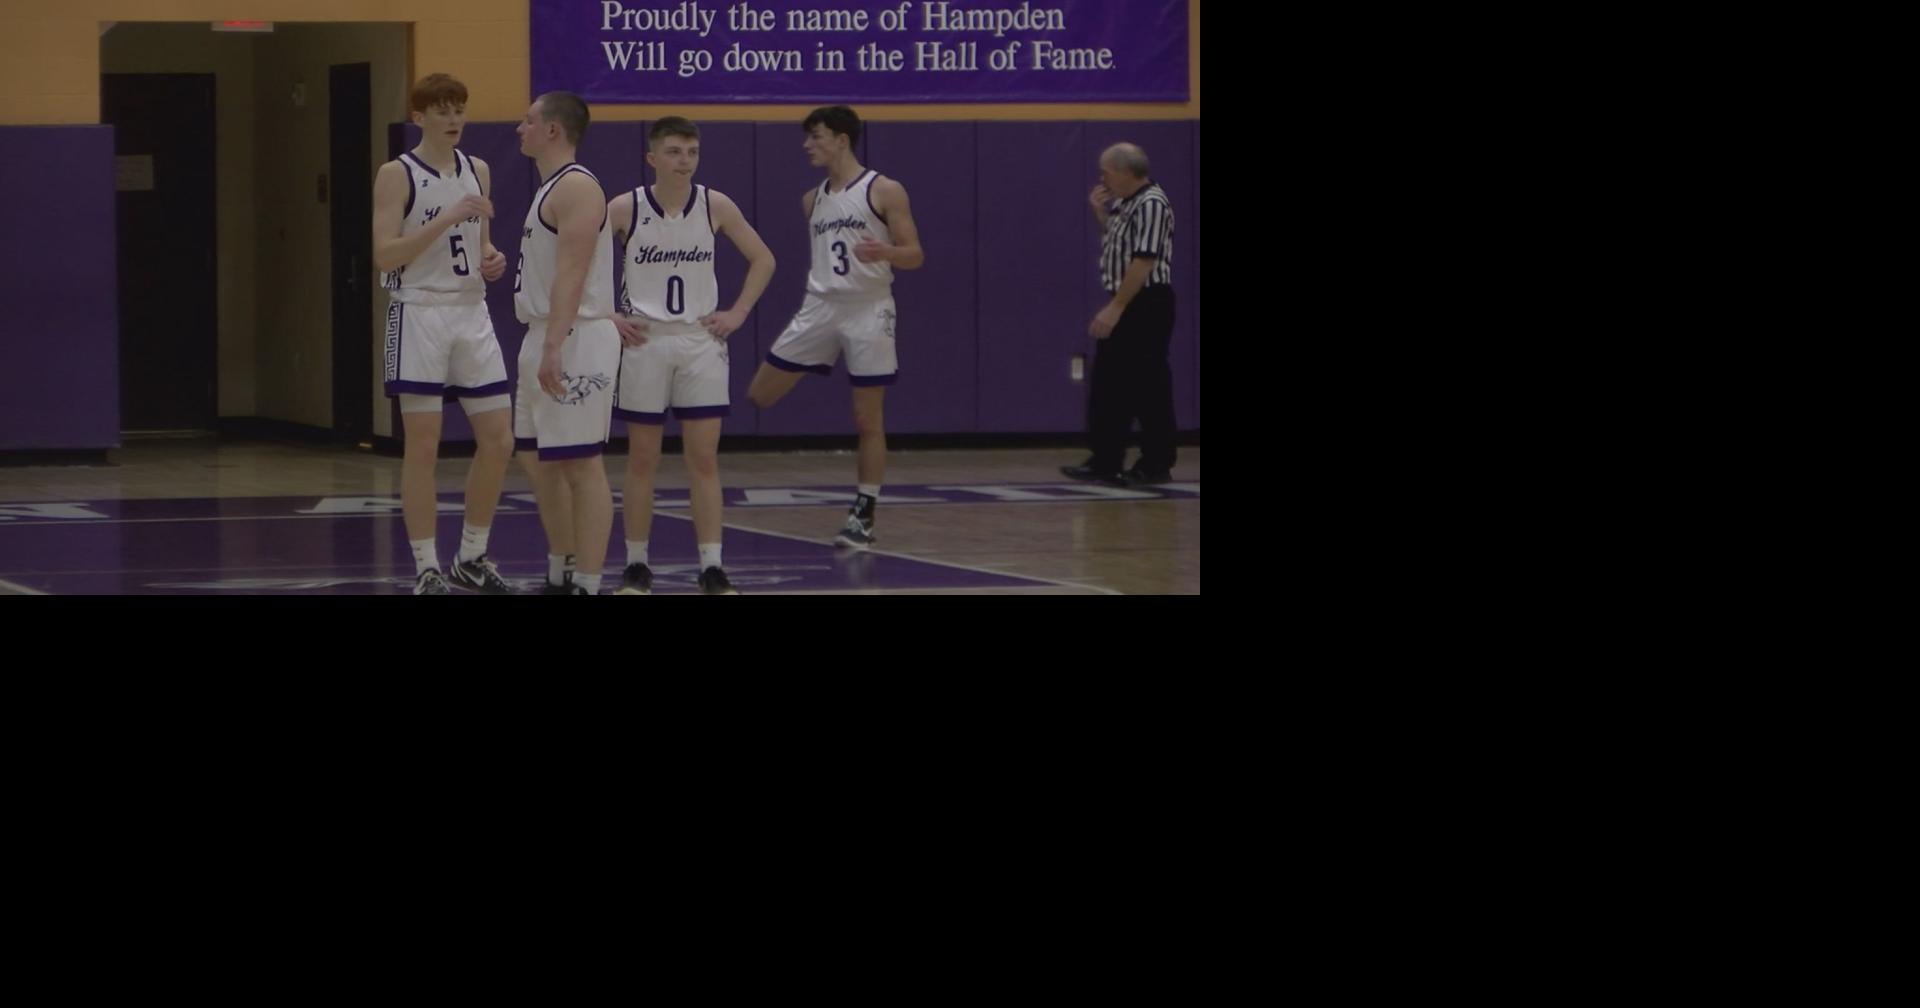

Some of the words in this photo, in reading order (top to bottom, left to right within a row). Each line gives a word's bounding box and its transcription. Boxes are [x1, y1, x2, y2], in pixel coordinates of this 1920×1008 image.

[600, 0, 716, 37] Proudly
[728, 2, 776, 31] the
[787, 9, 869, 31] name
[879, 1, 912, 31] of
[922, 1, 1066, 37] Hampden
[601, 41, 668, 71] Will
[678, 49, 713, 77] go
[723, 43, 804, 71] down
[815, 42, 846, 71] in
[857, 42, 904, 71] the
[915, 42, 978, 71] Hall
[989, 41, 1022, 71] of
[1032, 40, 1116, 70] Fame.
[813, 213, 867, 238] Hampden
[449, 234, 469, 276] 5
[635, 245, 713, 268] Hampden
[830, 240, 850, 276] 3
[666, 275, 685, 315] 0
